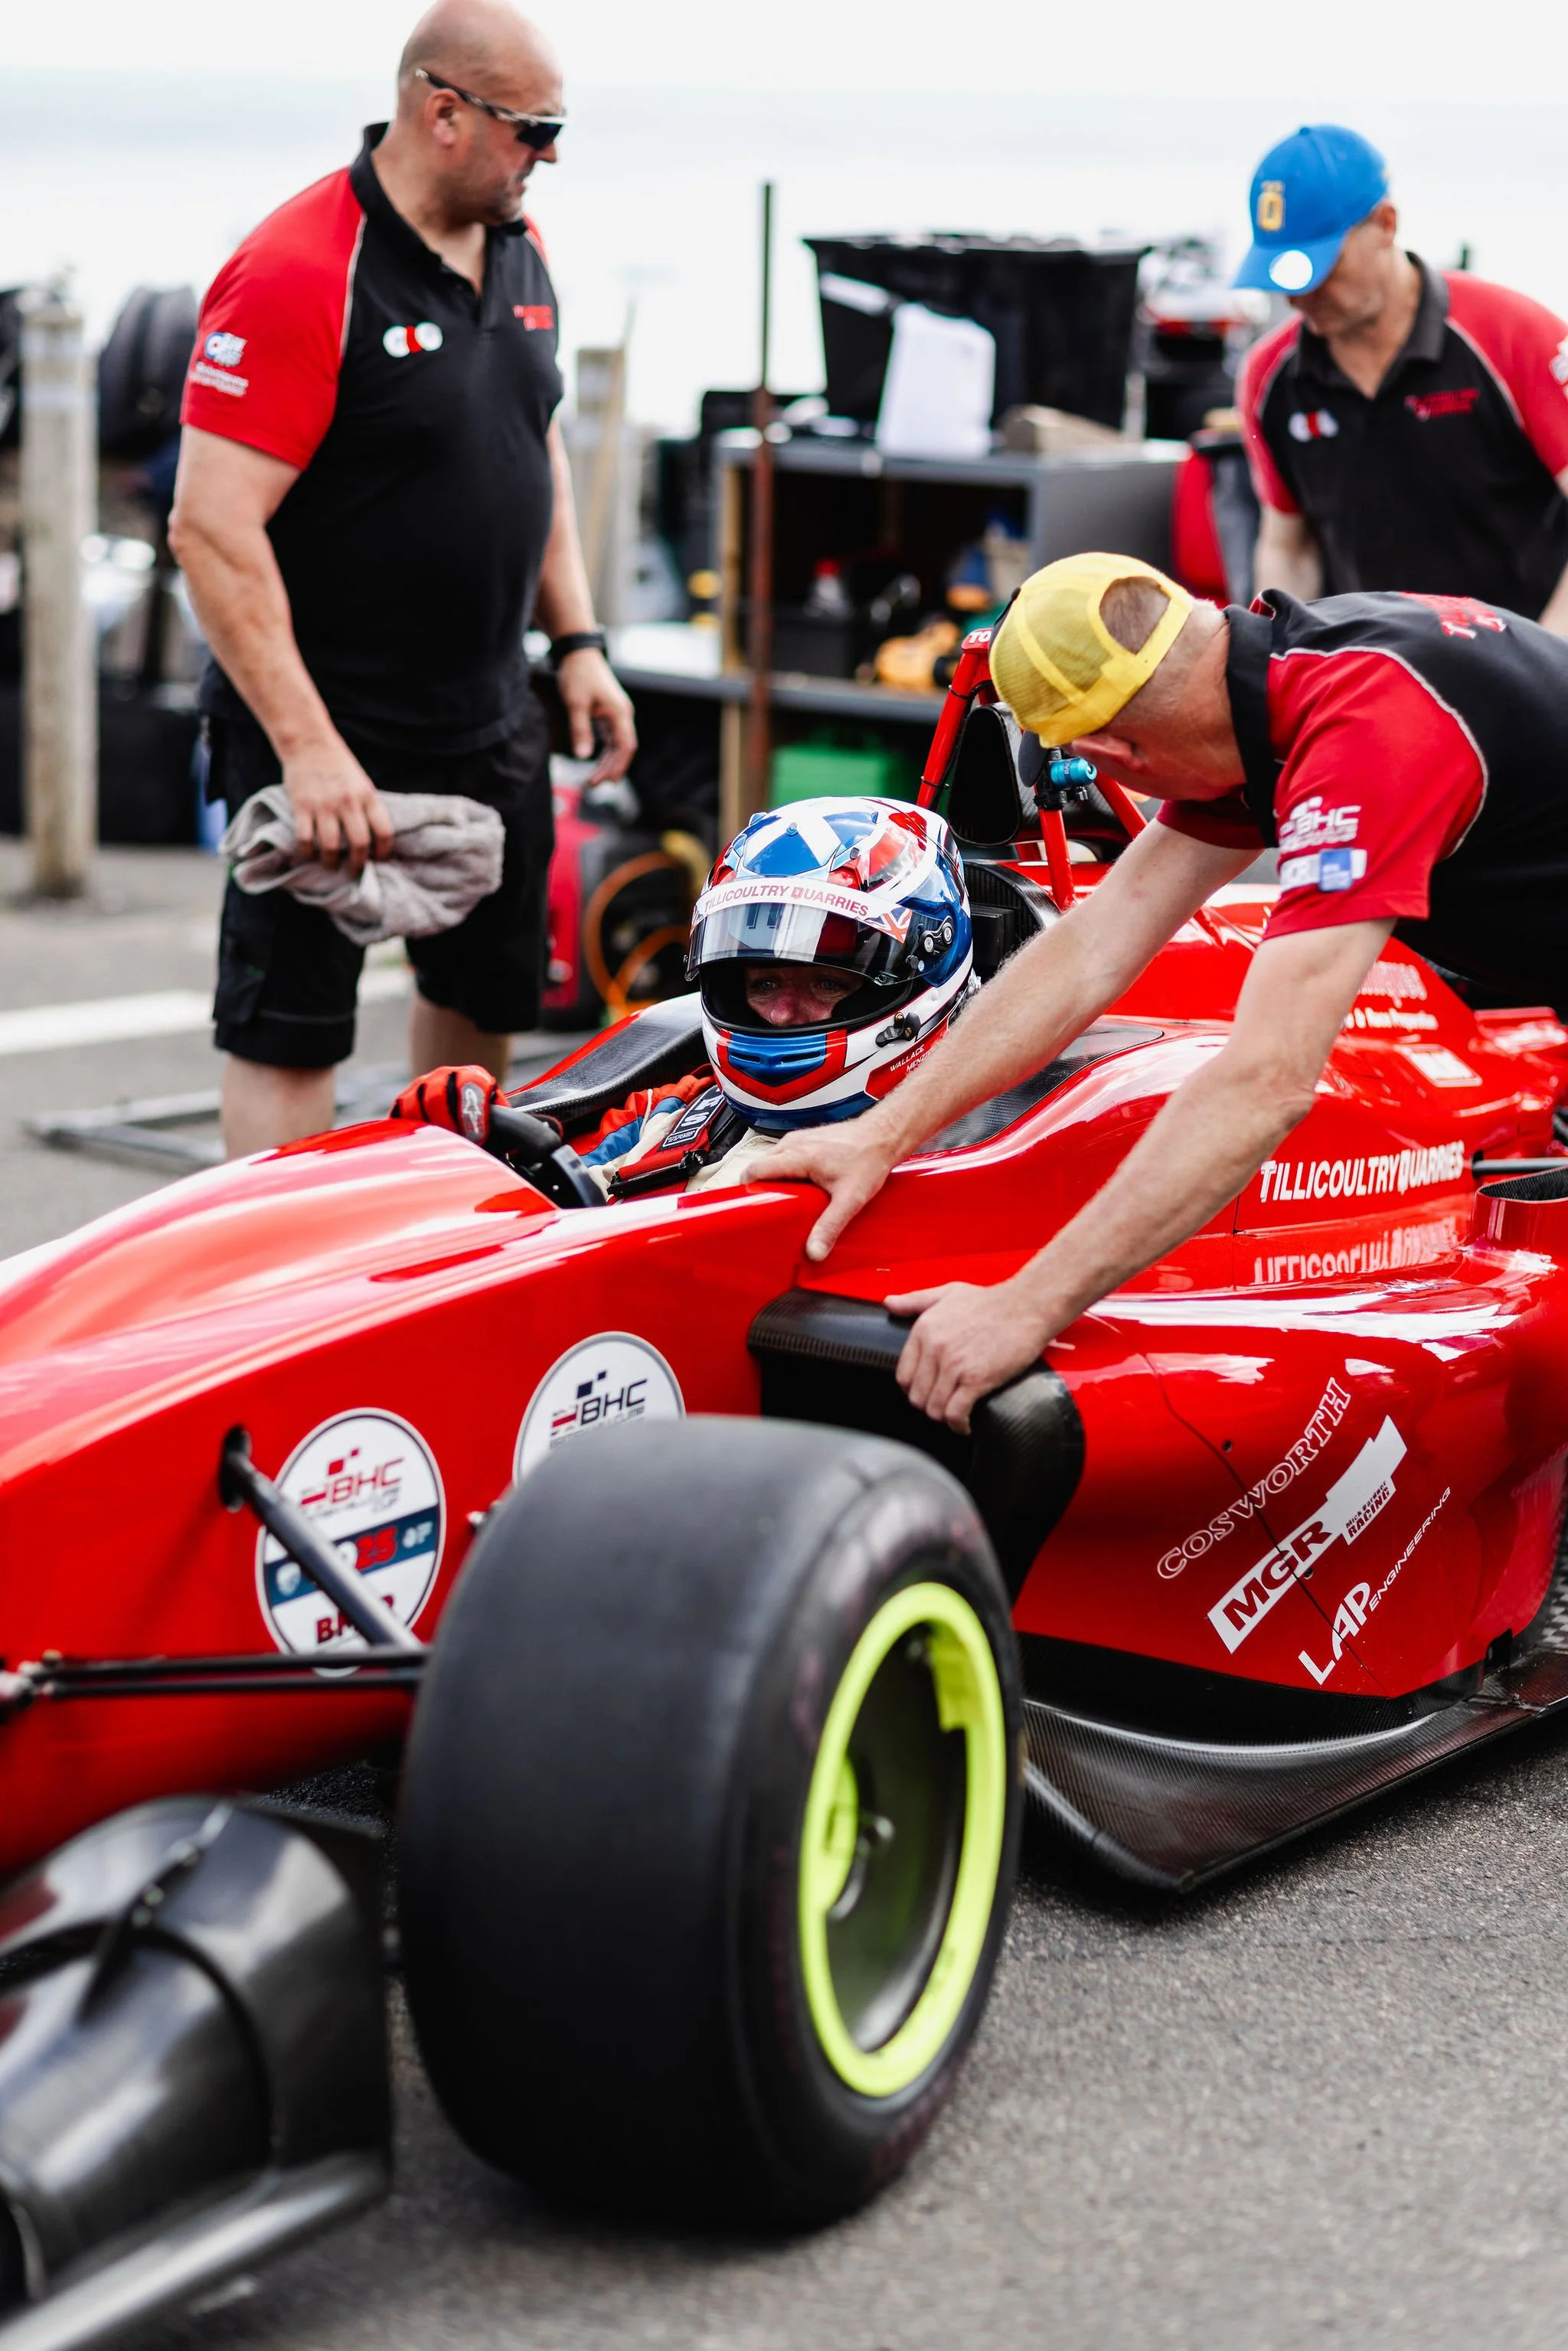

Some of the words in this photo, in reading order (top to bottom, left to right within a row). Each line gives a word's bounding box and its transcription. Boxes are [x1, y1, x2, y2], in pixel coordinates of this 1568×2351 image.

[705, 885, 790, 913] TILLICOULTRY
[791, 887, 869, 917] QUARRIES
[890, 1043, 925, 1072] WALLACE
[580, 1378, 648, 1426] BHC
[332, 1458, 404, 1504] BHC
[1157, 1377, 1351, 1579] COSWORTH
[1348, 1487, 1390, 1538] RACING
[1223, 1521, 1333, 1631] MGR
[1298, 1582, 1370, 1686] LAP
[1369, 1487, 1450, 1611] ENGINEERING
